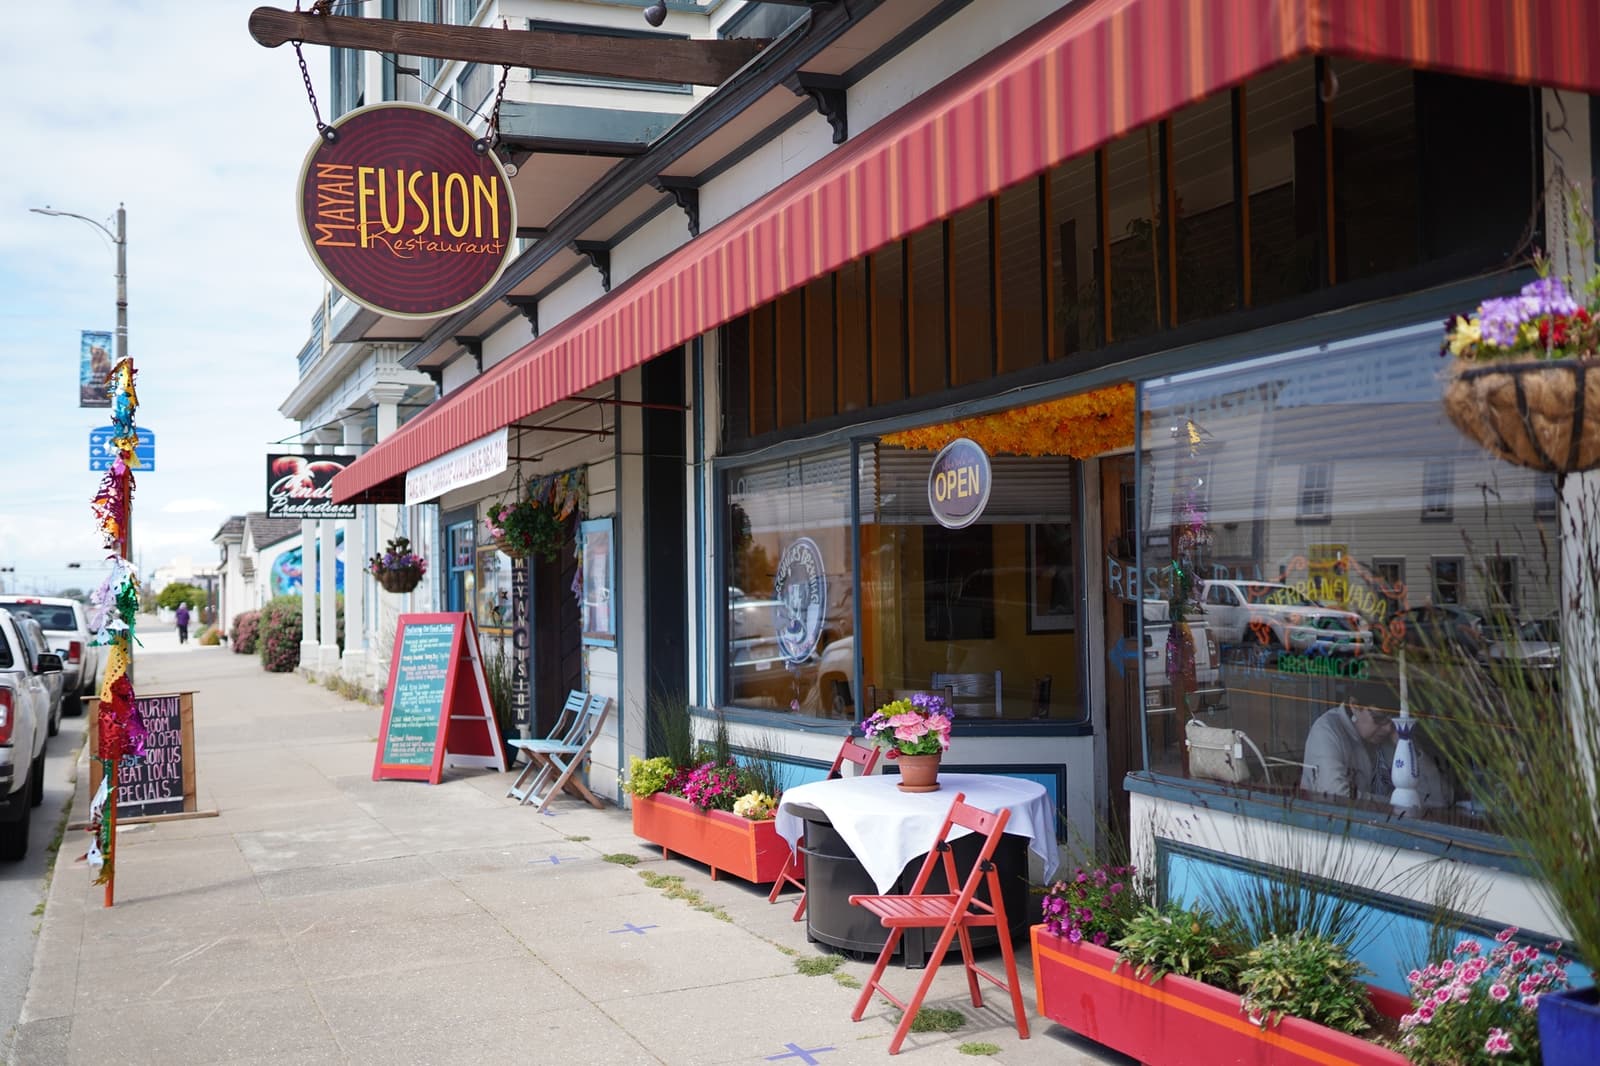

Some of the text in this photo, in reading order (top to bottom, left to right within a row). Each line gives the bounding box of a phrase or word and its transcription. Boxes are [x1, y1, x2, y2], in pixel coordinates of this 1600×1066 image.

[315, 163, 356, 247] MAYAN
[358, 166, 499, 248] FUSION
[357, 221, 504, 259] Restaurant
[935, 464, 980, 503] OPEN
[269, 497, 355, 513] Productions
[514, 558, 525, 627] MAYAN
[1265, 577, 1388, 623] SIERRA NEVADA
[1277, 654, 1345, 677] BREWING
[138, 697, 180, 718] AURANT
[158, 729, 182, 747] OPEN
[144, 748, 165, 765] JOIN
[167, 746, 181, 763] US
[118, 762, 180, 784] REAT LOCAL
[118, 779, 171, 802] PECIALS
